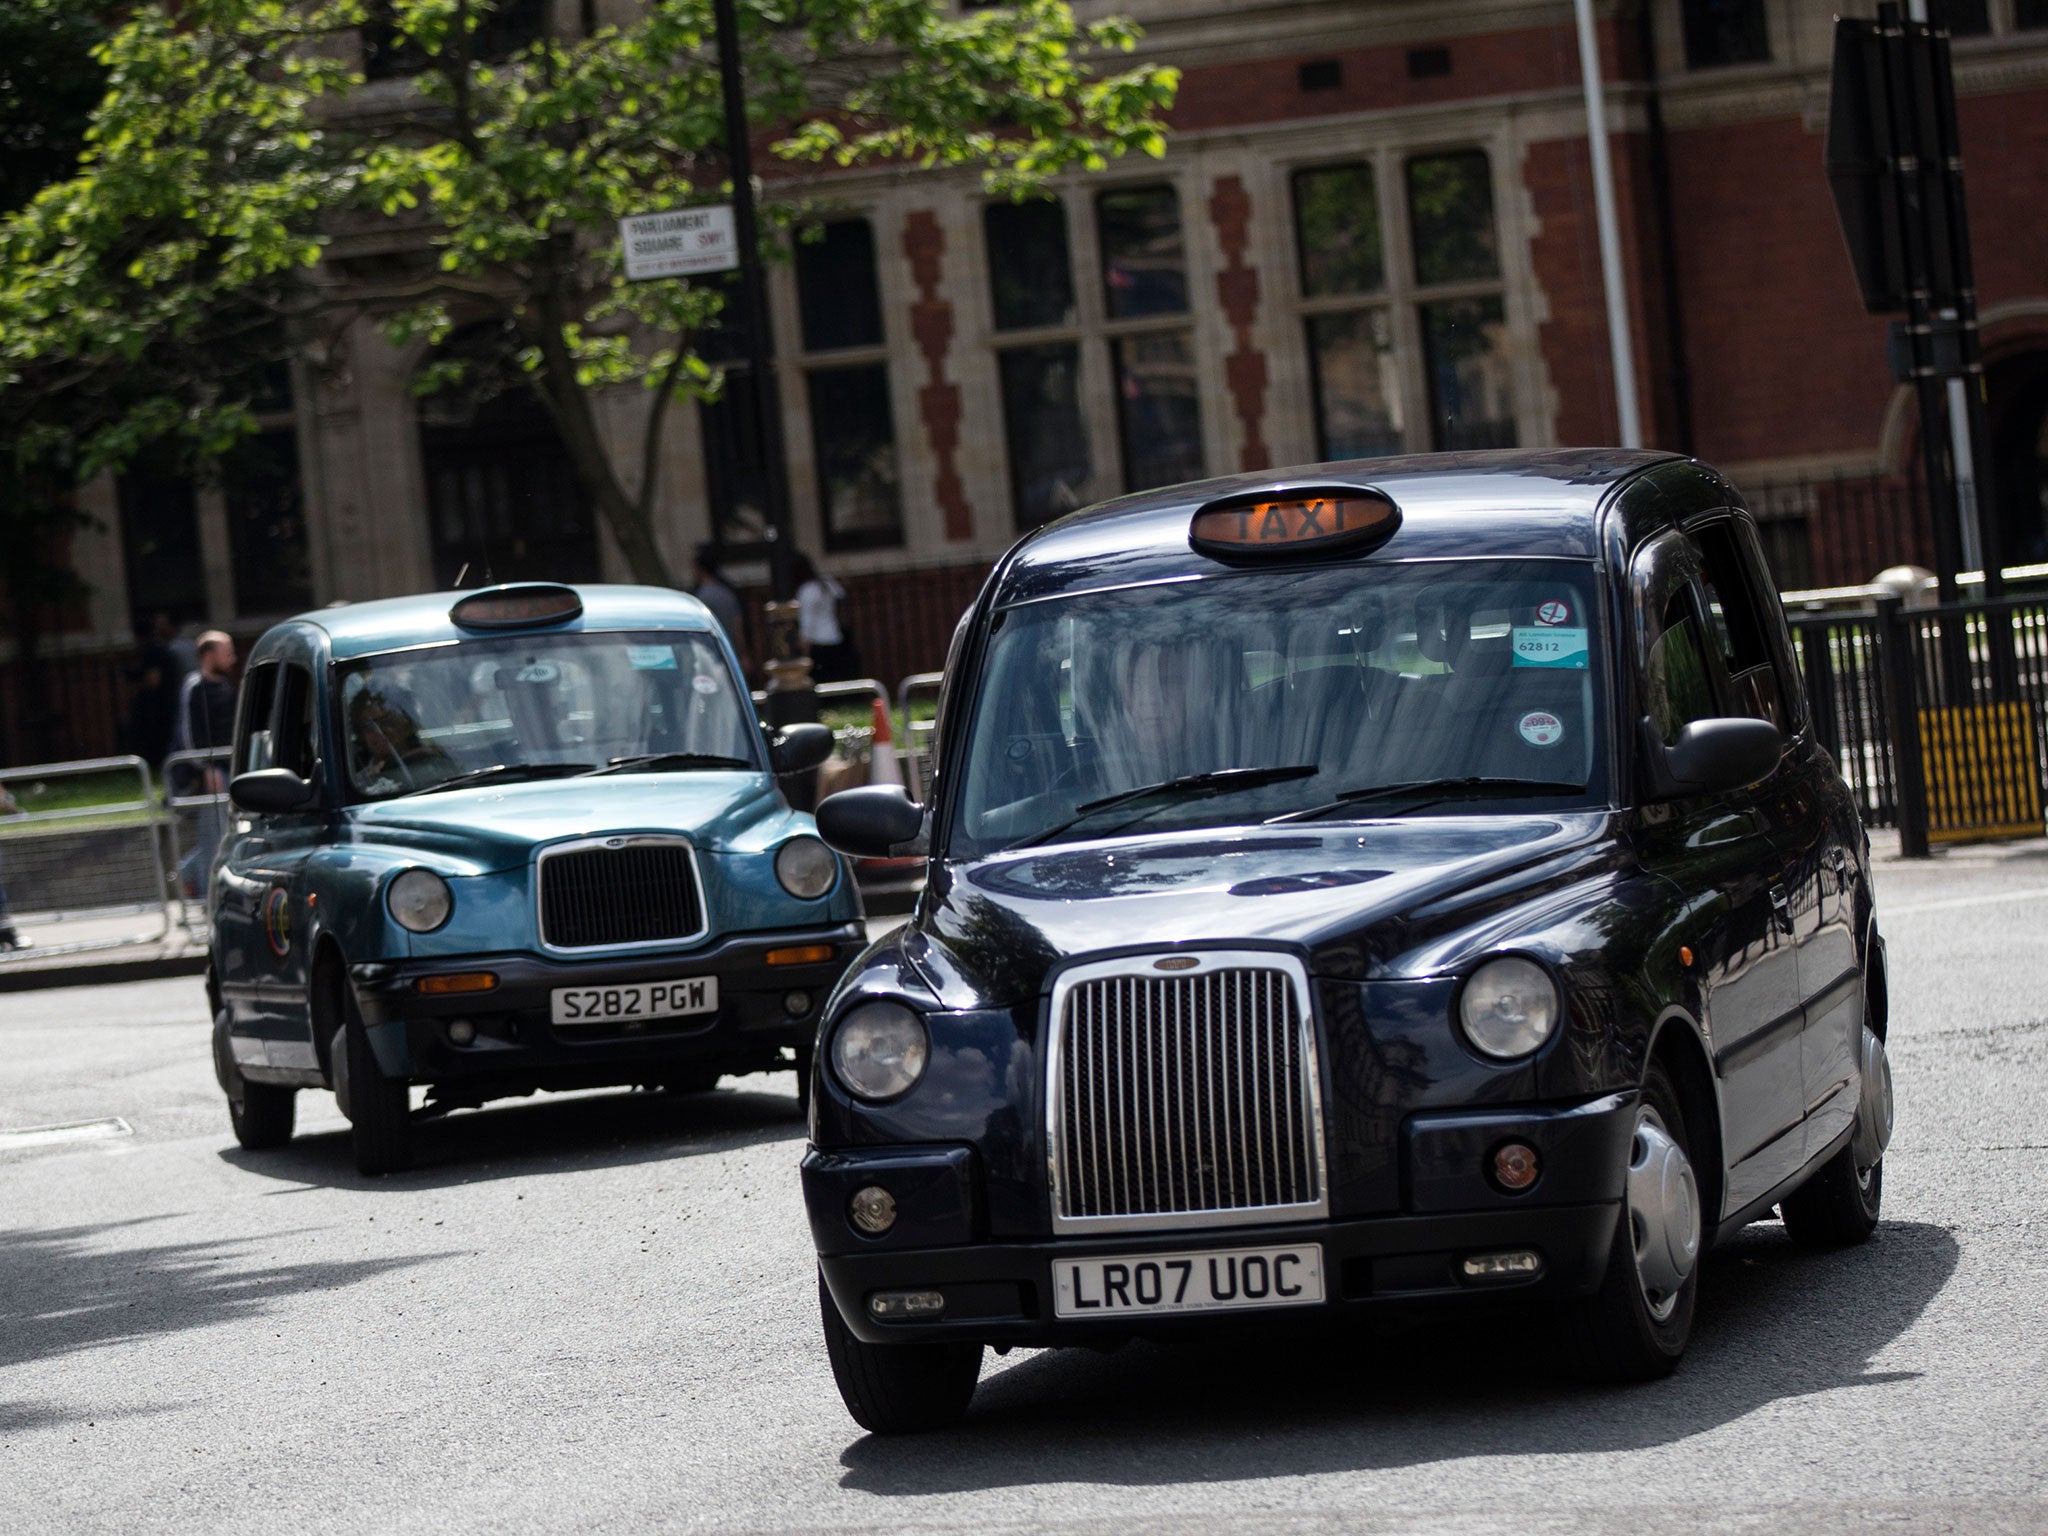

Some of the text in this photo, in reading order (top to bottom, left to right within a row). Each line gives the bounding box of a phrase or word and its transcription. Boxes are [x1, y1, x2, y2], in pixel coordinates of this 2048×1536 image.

[631, 214, 710, 235] PARLIAMENT
[1234, 501, 1345, 539] TAXI
[1519, 642, 1559, 651] 62812
[564, 980, 705, 1018] S282 PGW
[1072, 1253, 1302, 1309] LR07 UOC
